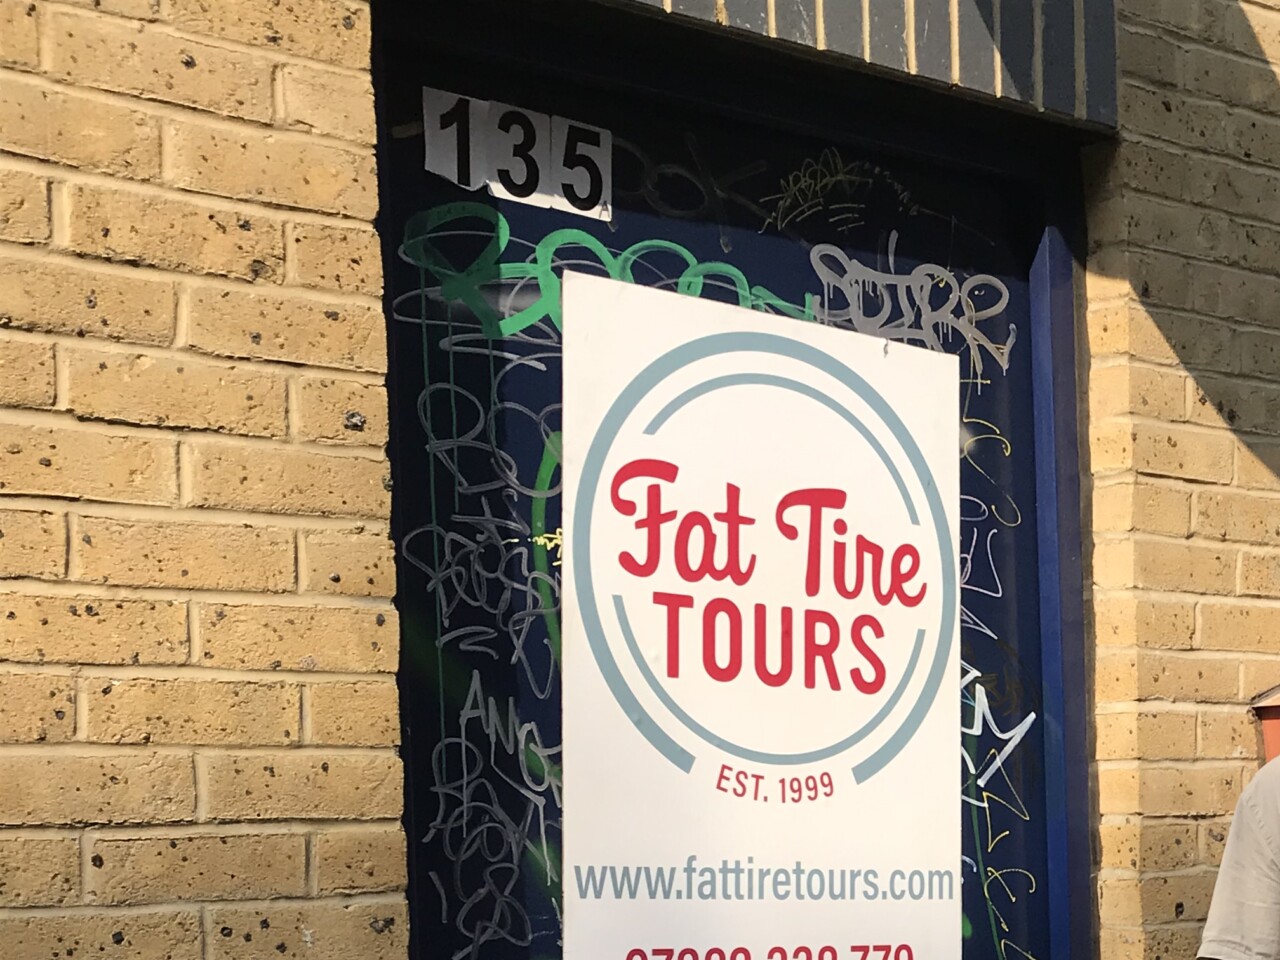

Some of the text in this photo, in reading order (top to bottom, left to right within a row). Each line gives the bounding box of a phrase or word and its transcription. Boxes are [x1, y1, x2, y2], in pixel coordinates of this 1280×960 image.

[439, 97, 603, 212] 135
[610, 458, 758, 587] Fat
[775, 488, 928, 608] Tire
[652, 592, 887, 696] TOURS
[715, 764, 835, 804] EST. 1999
[573, 854, 954, 902] www.fattiretours.com
